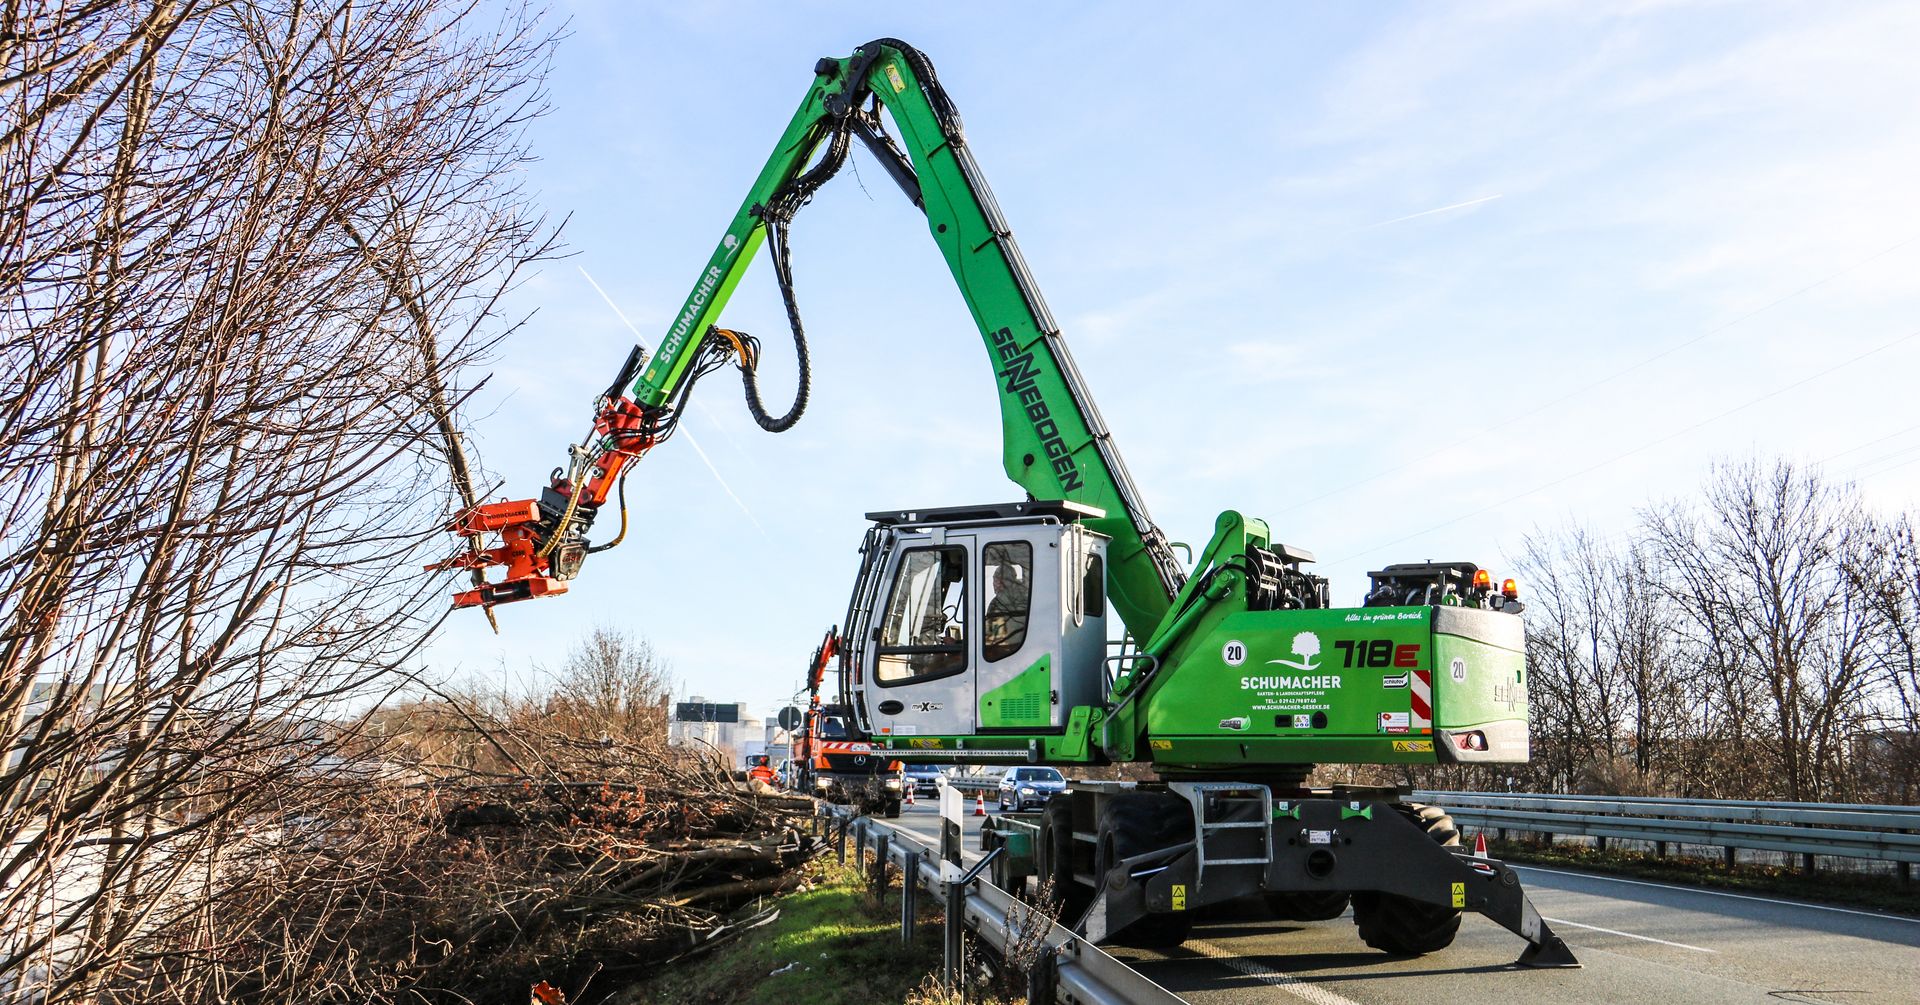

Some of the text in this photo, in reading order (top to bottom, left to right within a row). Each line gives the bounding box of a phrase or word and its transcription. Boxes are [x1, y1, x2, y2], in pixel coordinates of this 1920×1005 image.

[660, 265, 722, 364] SCHUMACHER
[991, 326, 1084, 493] SENNEBOGEN
[1345, 610, 1423, 623] Alles im grünen Bereich.
[1227, 645, 1242, 661] 20
[1334, 640, 1421, 669] 718E
[1453, 661, 1464, 679] 20
[1240, 675, 1342, 690] SCHUMACHER
